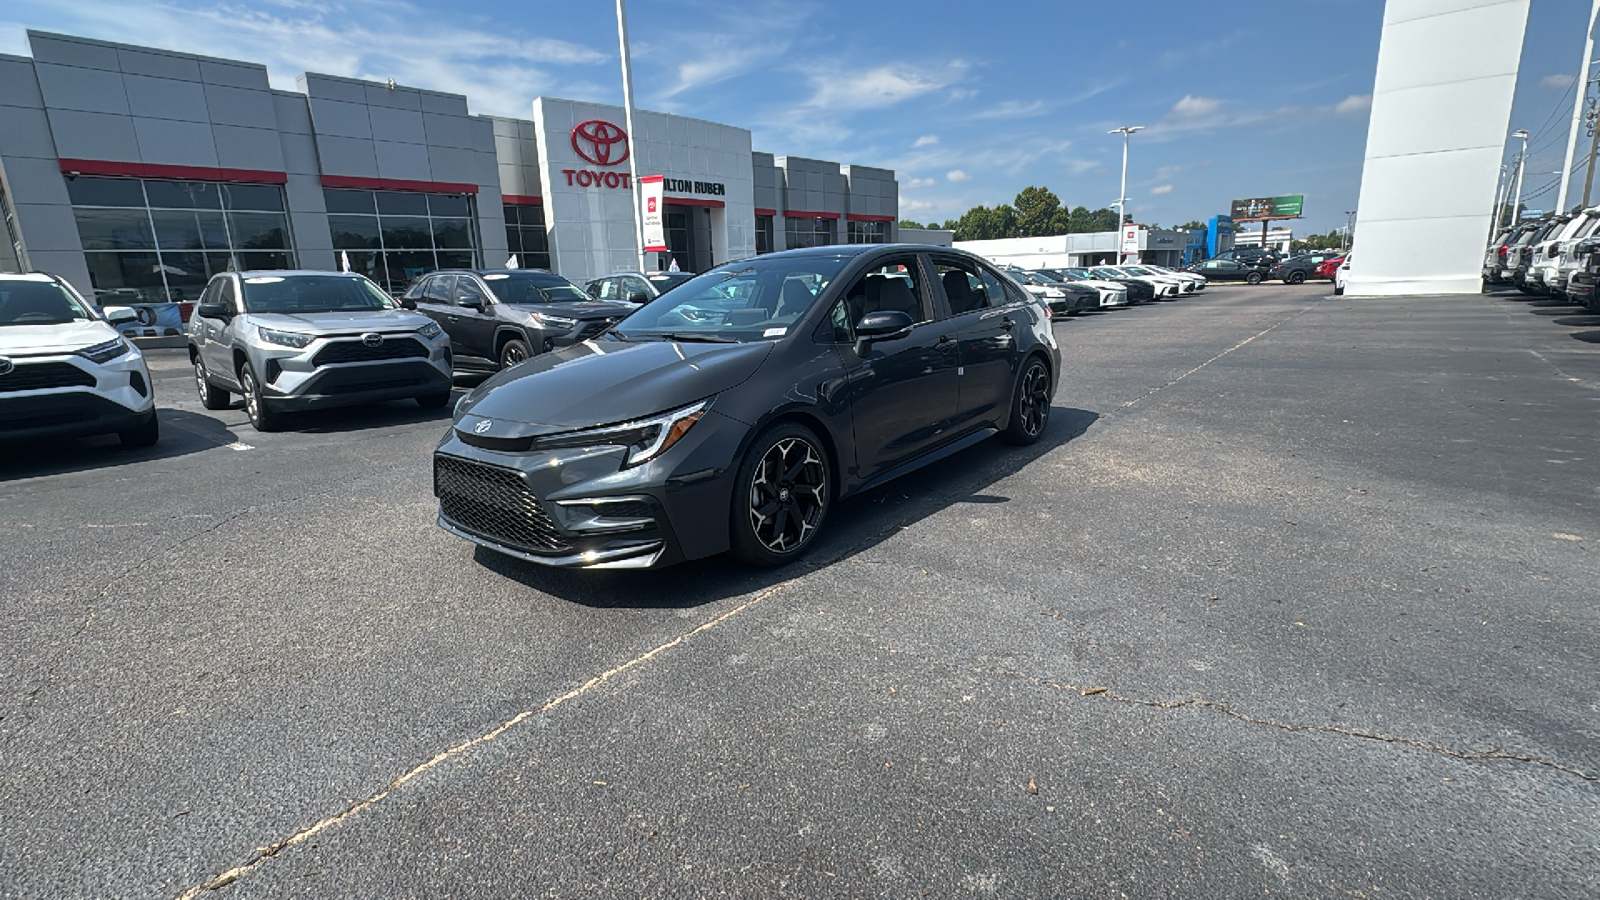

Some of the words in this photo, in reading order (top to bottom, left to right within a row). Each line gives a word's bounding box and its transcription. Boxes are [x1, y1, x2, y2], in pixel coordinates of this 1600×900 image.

[562, 168, 633, 189] TOYOT
[663, 177, 692, 193] ILTON
[694, 181, 725, 196] RUBEN
